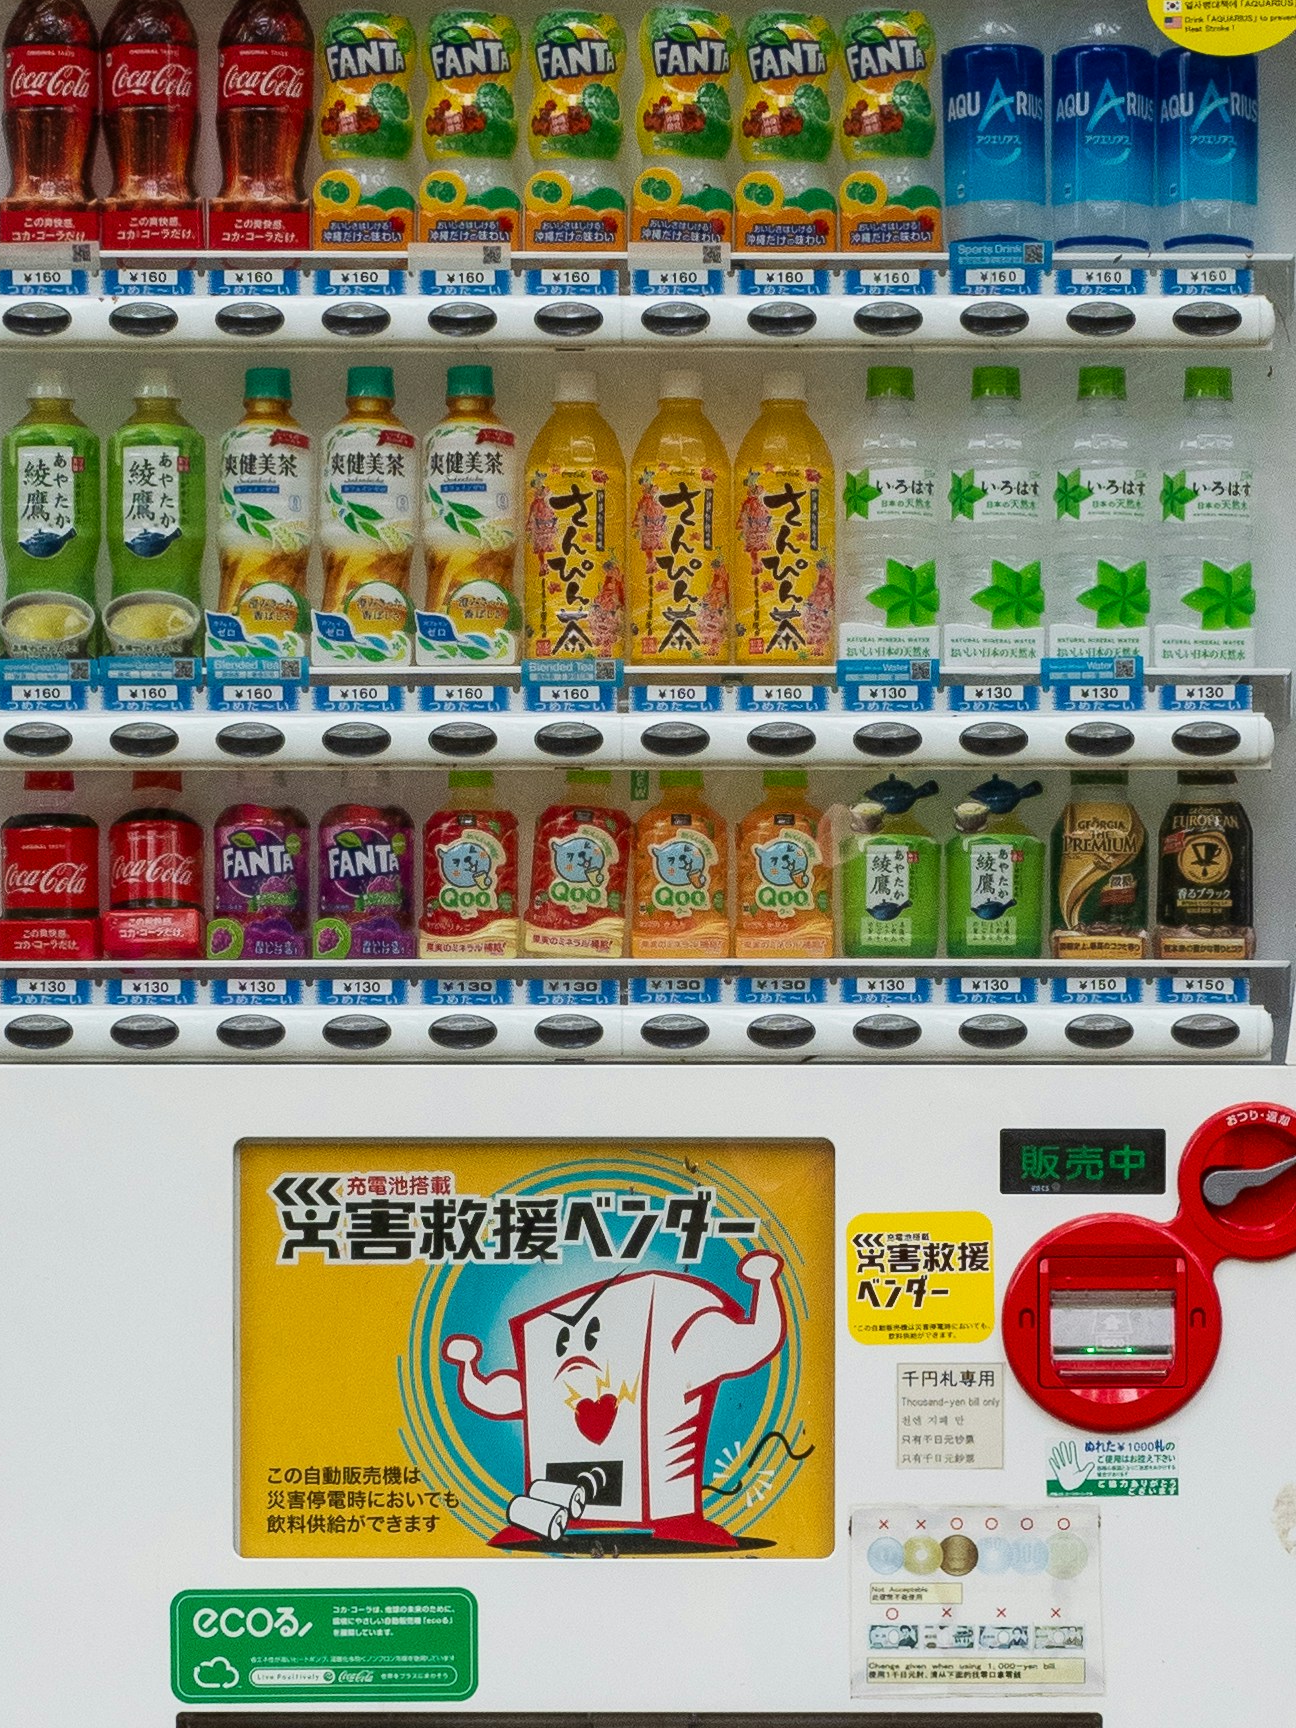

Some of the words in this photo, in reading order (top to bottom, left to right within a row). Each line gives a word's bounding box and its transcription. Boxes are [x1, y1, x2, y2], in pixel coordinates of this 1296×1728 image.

[327, 41, 404, 79] FANTA
[432, 41, 510, 79] FANTA
[537, 42, 615, 79] FANTA
[654, 40, 729, 74] FANTA
[748, 42, 826, 78] FANTA
[847, 40, 925, 78] FANTA
[10, 64, 90, 98] Coca-Cola
[112, 64, 192, 98] Coca-Cola
[223, 64, 304, 98] Coca-Cola
[948, 78, 1043, 132] AQUARIUS
[1056, 78, 1154, 132] AQUARIUS
[1161, 78, 1257, 134] AQUARIUS
[24, 272, 61, 283] ¥160
[235, 272, 273, 283] ¥160
[341, 272, 378, 283] ¥160
[552, 272, 590, 283] ¥160
[660, 272, 697, 283] ¥160
[873, 272, 910, 283] ¥160
[980, 271, 1017, 282] ¥160
[1191, 270, 1227, 282] ¥160
[225, 453, 298, 477] 爽健美茶
[331, 451, 405, 477] 爽健美茶
[431, 451, 504, 476] 爽健美茶
[21, 458, 54, 522] 綾鷹
[54, 452, 72, 529] あやたか
[124, 458, 159, 522] 綾鷹
[881, 498, 932, 508] 日本の天然水
[547, 484, 594, 656] さんぴん茶
[656, 482, 702, 653] さんぴん茶
[762, 482, 808, 654] さんぴん茶
[950, 645, 1038, 659] おいしい日本の天然水
[214, 659, 259, 670] Blended
[261, 659, 279, 670] Tea
[1087, 660, 1114, 671] Water
[23, 687, 60, 699] ¥160
[235, 688, 272, 699] ¥160
[446, 688, 482, 699] ¥160
[659, 688, 696, 699] ¥160
[869, 687, 907, 699] ¥130
[1081, 687, 1119, 699] ¥130
[1186, 687, 1224, 698] ¥130
[1077, 817, 1126, 830] GEORGIA
[1173, 815, 1239, 829] EUROPEAN
[1064, 835, 1137, 853] PREMIUM
[111, 852, 195, 888] Coca-Cola
[222, 845, 294, 880] FANTA
[328, 844, 400, 879] FANTA
[5, 862, 88, 894] Coca-Cola
[869, 854, 894, 896] 綾鷹
[893, 847, 905, 900] あやたか
[973, 852, 996, 895] 綾鷹
[440, 888, 491, 908] Qoo
[550, 882, 602, 904] Qoo
[655, 886, 707, 906] Qoo
[758, 886, 809, 906] Qoo
[1177, 888, 1231, 900] 香るブラック
[29, 981, 66, 992] ¥130
[238, 980, 276, 992] ¥130
[444, 981, 492, 992] ¥130
[757, 979, 806, 990] ¥130
[972, 979, 1009, 991] ¥130
[1186, 979, 1225, 991] ¥150
[1226, 1110, 1291, 1127] おつり・返却
[1020, 1144, 1146, 1180] 販売中
[346, 1175, 452, 1196] 充電池搭載
[272, 1176, 760, 1261] 災害救援ベンダー
[853, 1234, 989, 1273] 災害救援
[858, 1275, 949, 1307] ベンダー
[902, 1370, 995, 1387] 千円札専用
[902, 1397, 965, 1408] Thousand-yen
[969, 1398, 979, 1406] bill
[983, 1398, 1000, 1408] only
[1085, 1439, 1176, 1452] ぬれた¥1000札の
[1097, 1454, 1176, 1463] ご使用はお控え下さい
[266, 1466, 422, 1487] この自動販売機は
[266, 1490, 460, 1511] 災害停電時においても
[266, 1514, 440, 1535] 飲料供給ができます
[905, 1663, 926, 1671] given
[959, 1663, 982, 1671] using
